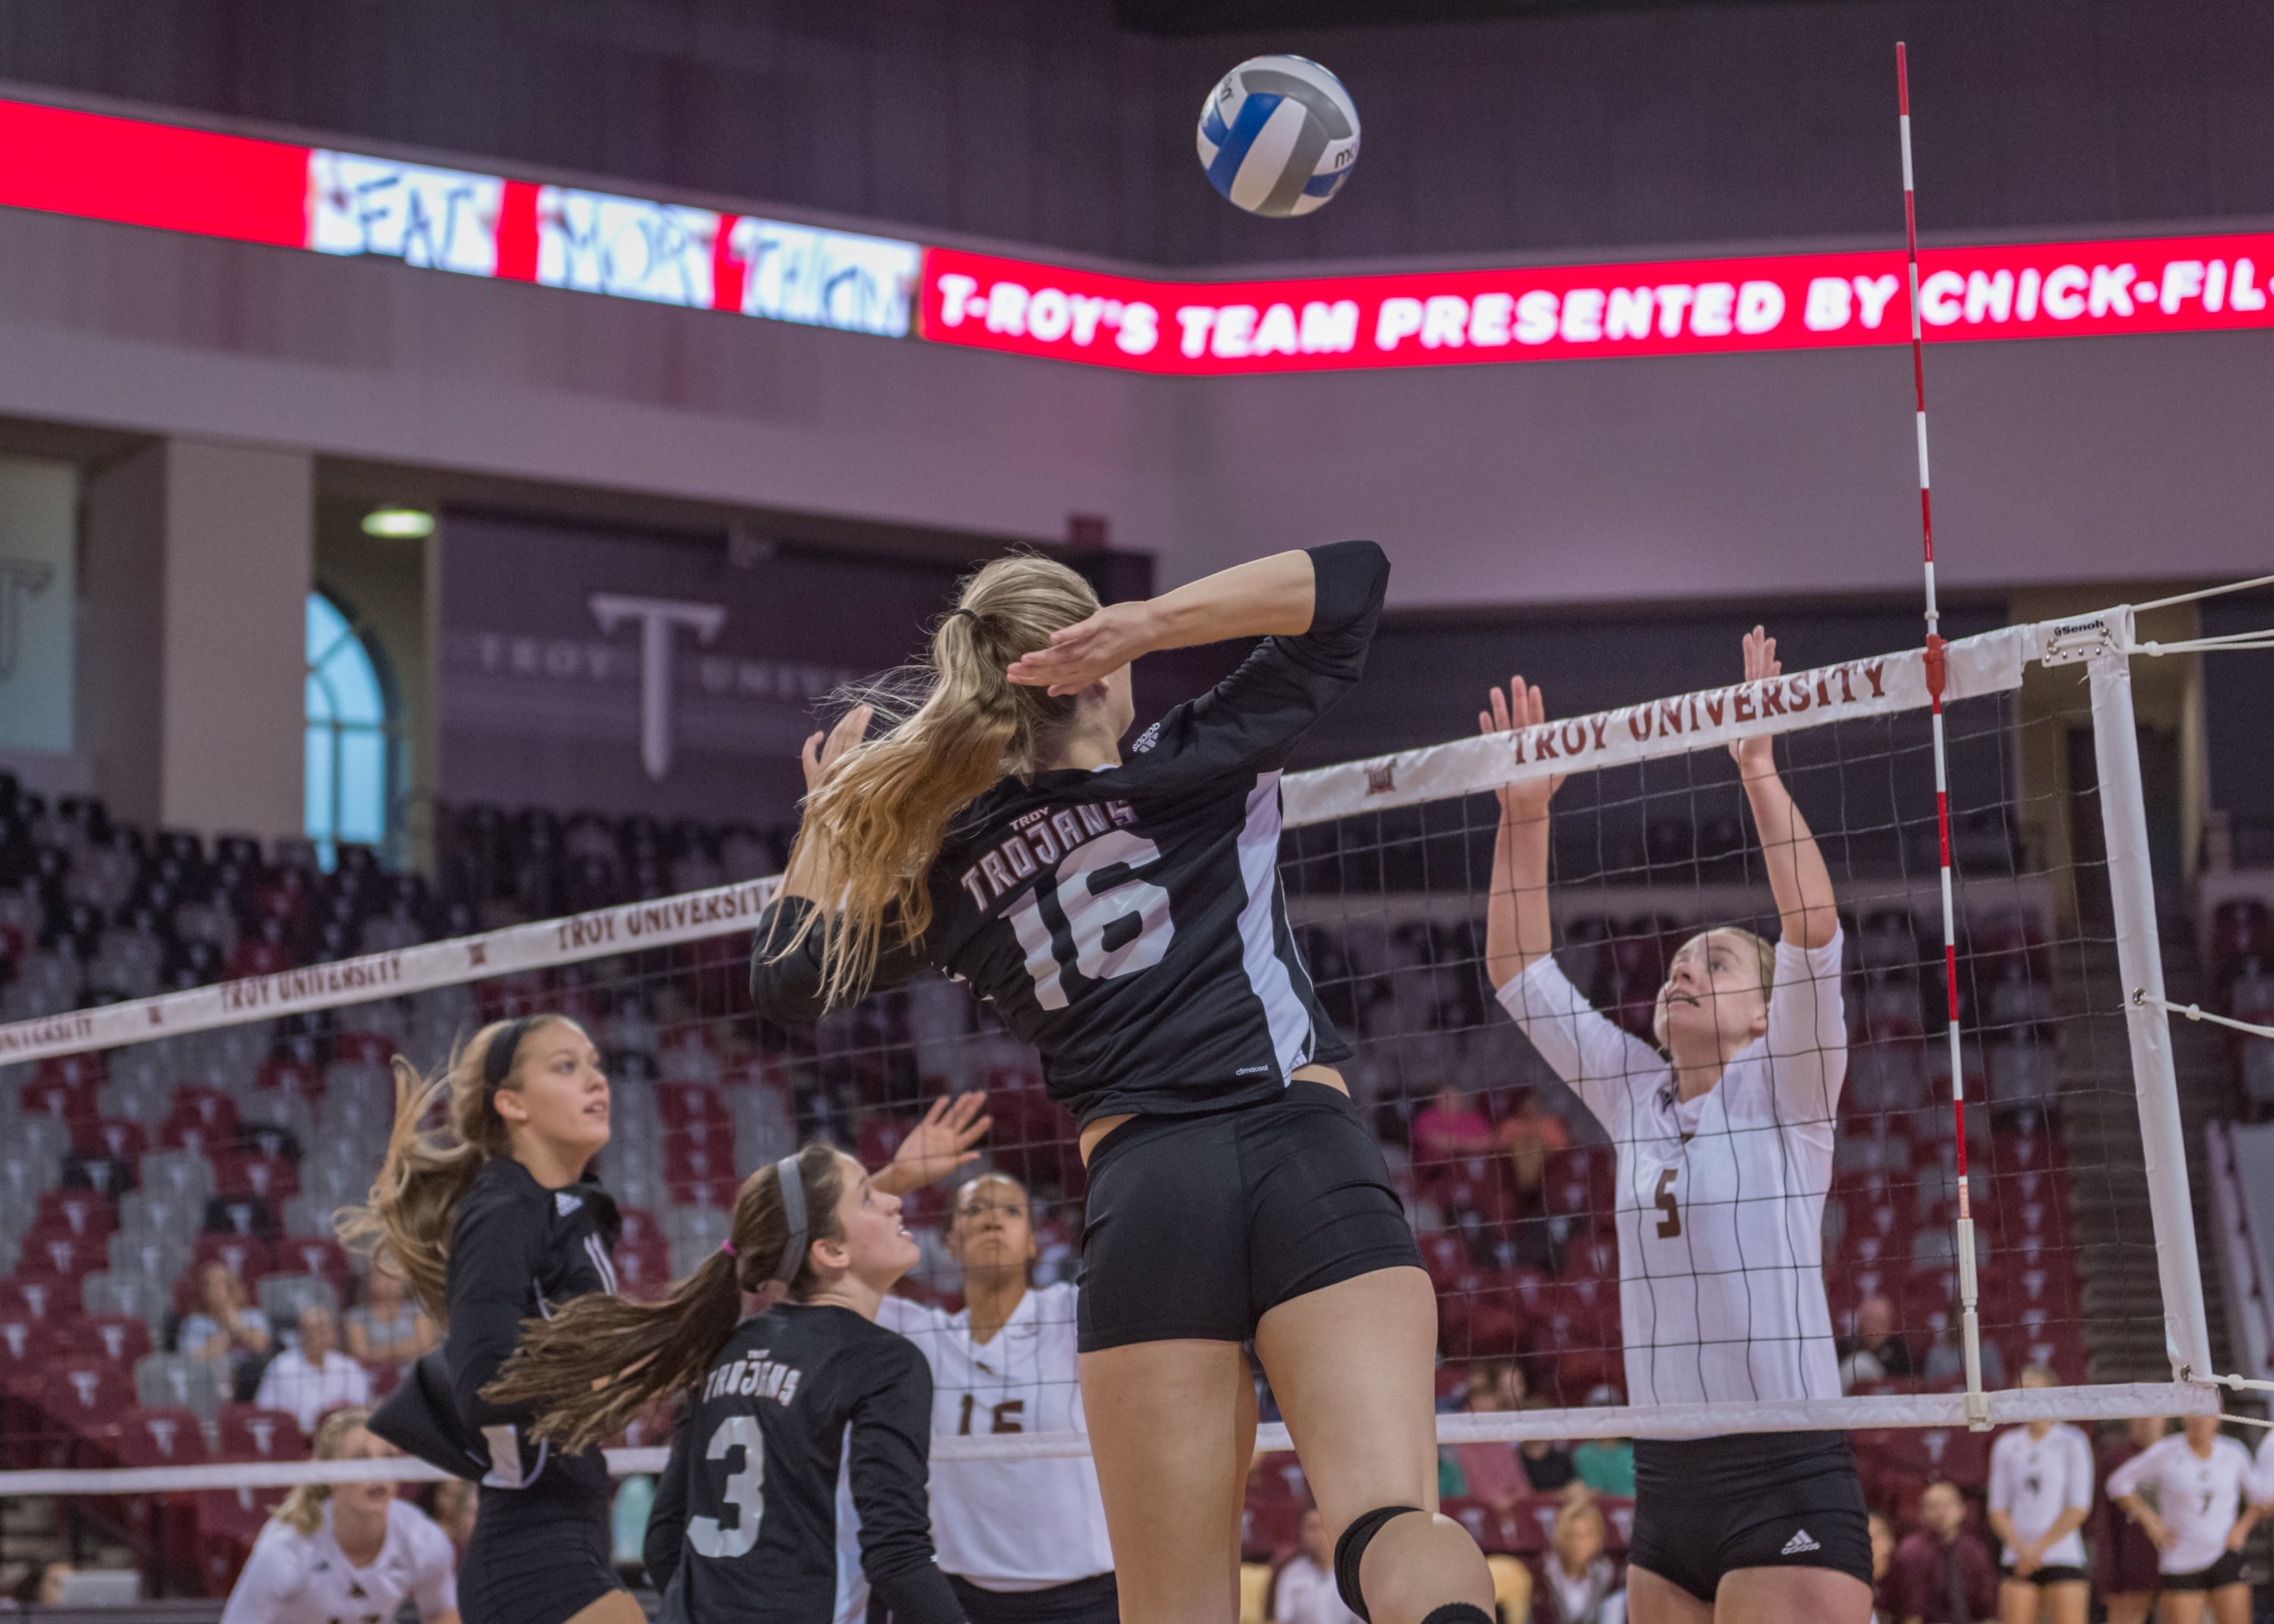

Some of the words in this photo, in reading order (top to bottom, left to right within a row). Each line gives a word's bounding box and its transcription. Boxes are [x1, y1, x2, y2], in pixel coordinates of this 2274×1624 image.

[938, 274, 1158, 355] T-ROY'S
[1176, 300, 1359, 358] TEAM
[1375, 280, 1786, 351] PRESENTED
[1804, 274, 1899, 331] BY
[1918, 257, 2274, 326] CHICK-FIL
[587, 593, 726, 781] T
[1132, 722, 1160, 752] adidas
[1508, 714, 1608, 764] TROY
[1628, 658, 1886, 743] UNIVERSITY
[960, 798, 1139, 912] TROJANS
[1008, 806, 1051, 832] TROY
[557, 912, 615, 950] TROY
[998, 829, 1176, 1011] 16
[1654, 1168, 1682, 1240] 5
[702, 1359, 802, 1407] TROJANS
[685, 1415, 765, 1559] 3
